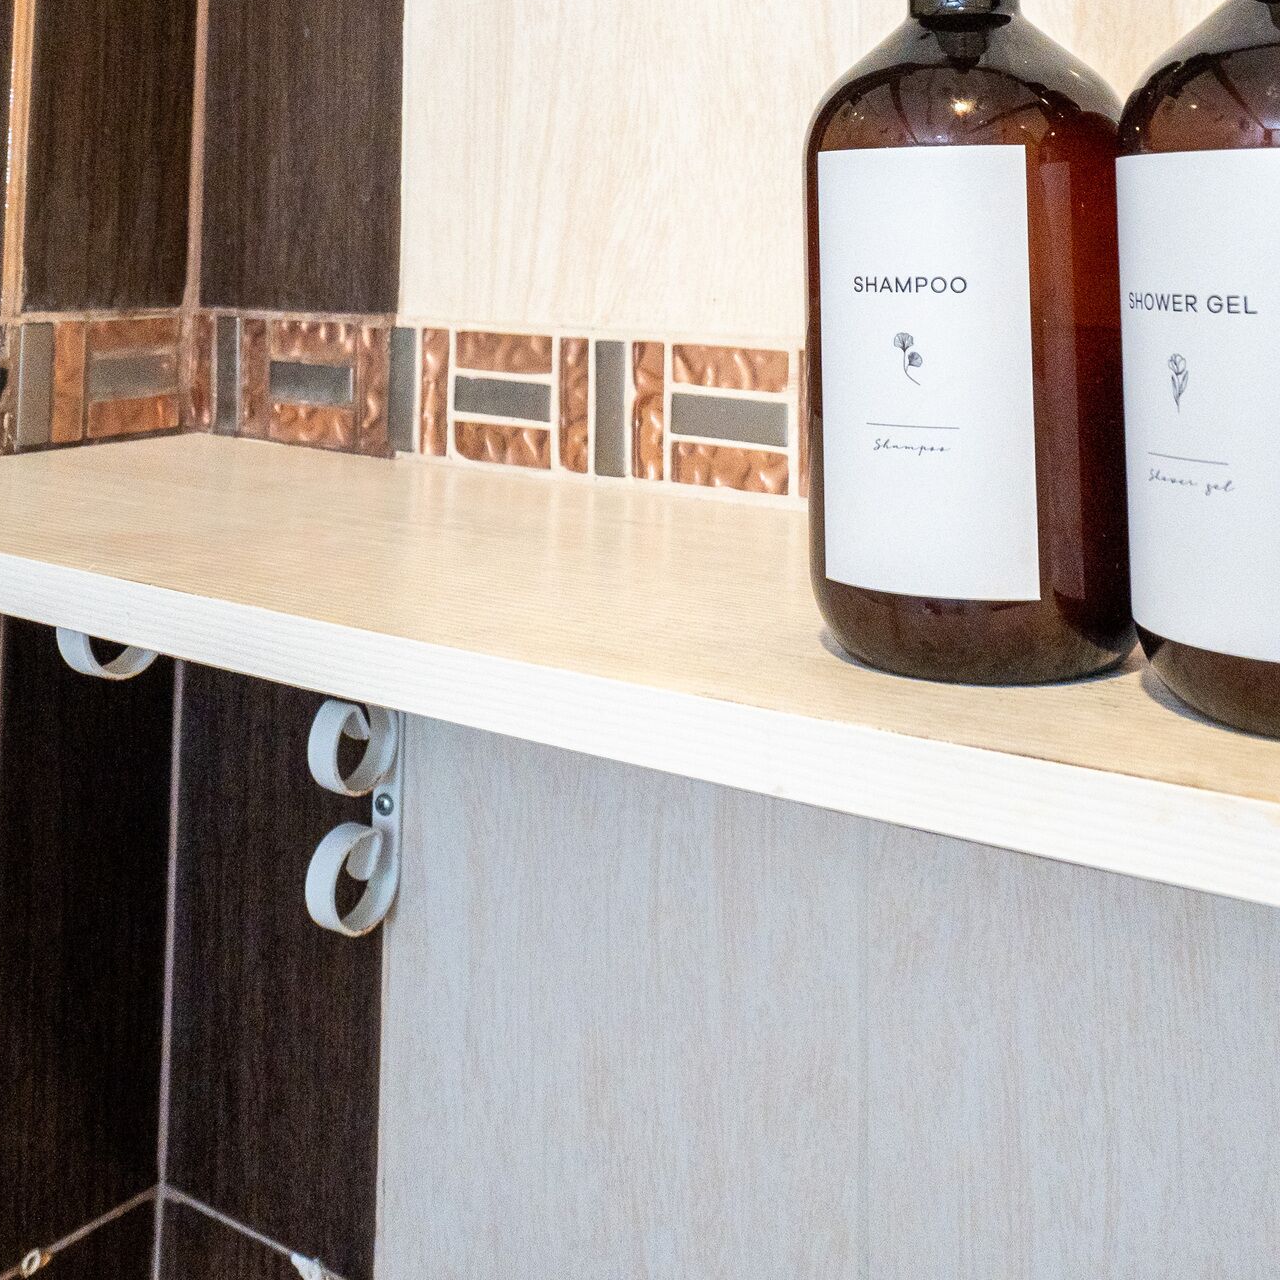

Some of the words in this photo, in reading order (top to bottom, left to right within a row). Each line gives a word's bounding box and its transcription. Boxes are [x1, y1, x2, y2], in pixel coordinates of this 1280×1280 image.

[853, 276, 967, 293] SHAMPOO
[1129, 292, 1198, 312] SHOWER
[1207, 295, 1258, 314] GEL
[873, 438, 951, 456] Shampoo
[1205, 480, 1235, 496] gel
